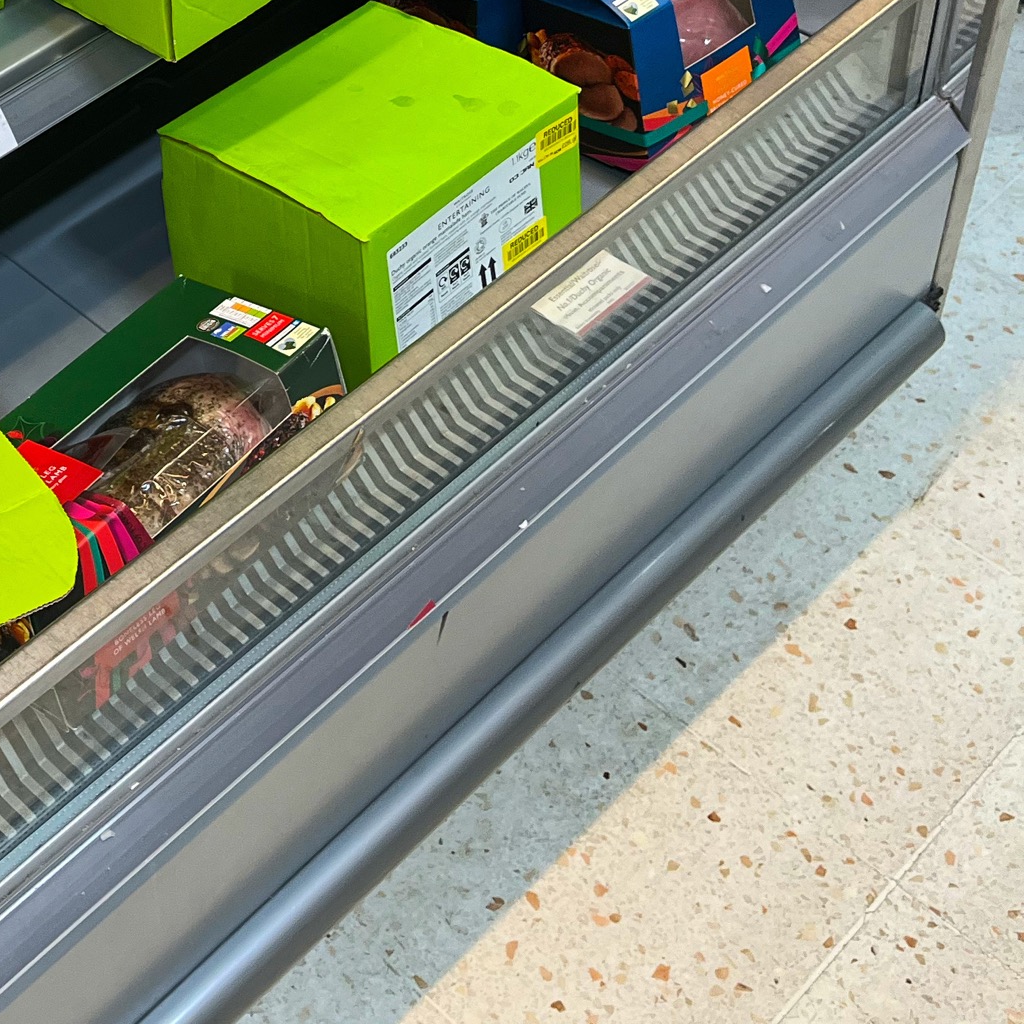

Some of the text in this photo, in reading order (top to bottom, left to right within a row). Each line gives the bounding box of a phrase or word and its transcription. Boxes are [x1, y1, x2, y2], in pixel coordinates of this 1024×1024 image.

[543, 116, 573, 138] REDUCED
[437, 186, 490, 230] ENTERTAINING
[510, 225, 539, 249] REDUCED
[40, 466, 56, 478] LEG
[46, 466, 67, 484] LAMB
[114, 646, 122, 655] OF
[148, 608, 166, 625] LAMB
